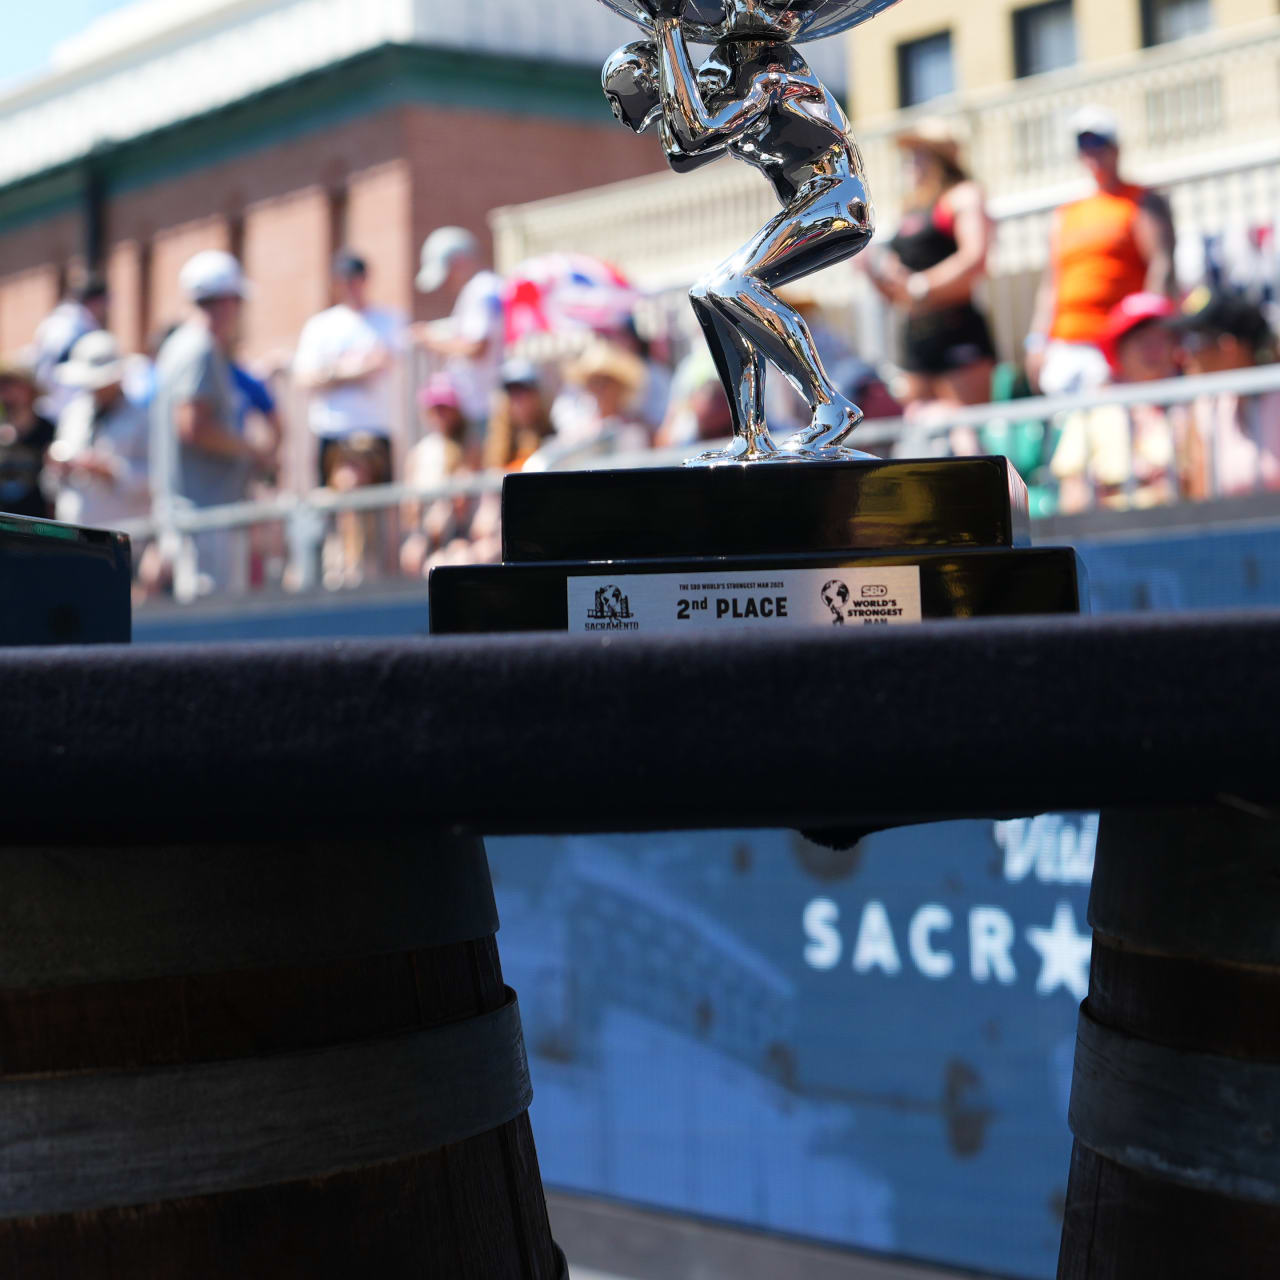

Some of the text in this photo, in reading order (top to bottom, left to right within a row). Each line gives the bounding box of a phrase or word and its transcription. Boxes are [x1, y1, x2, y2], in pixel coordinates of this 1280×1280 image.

[861, 585, 888, 597] SBD
[677, 597, 788, 619] 2nd PLACE
[852, 599, 897, 607] WORLD'S
[847, 608, 903, 617] STRONGEST
[584, 621, 639, 631] SACRAMENTO
